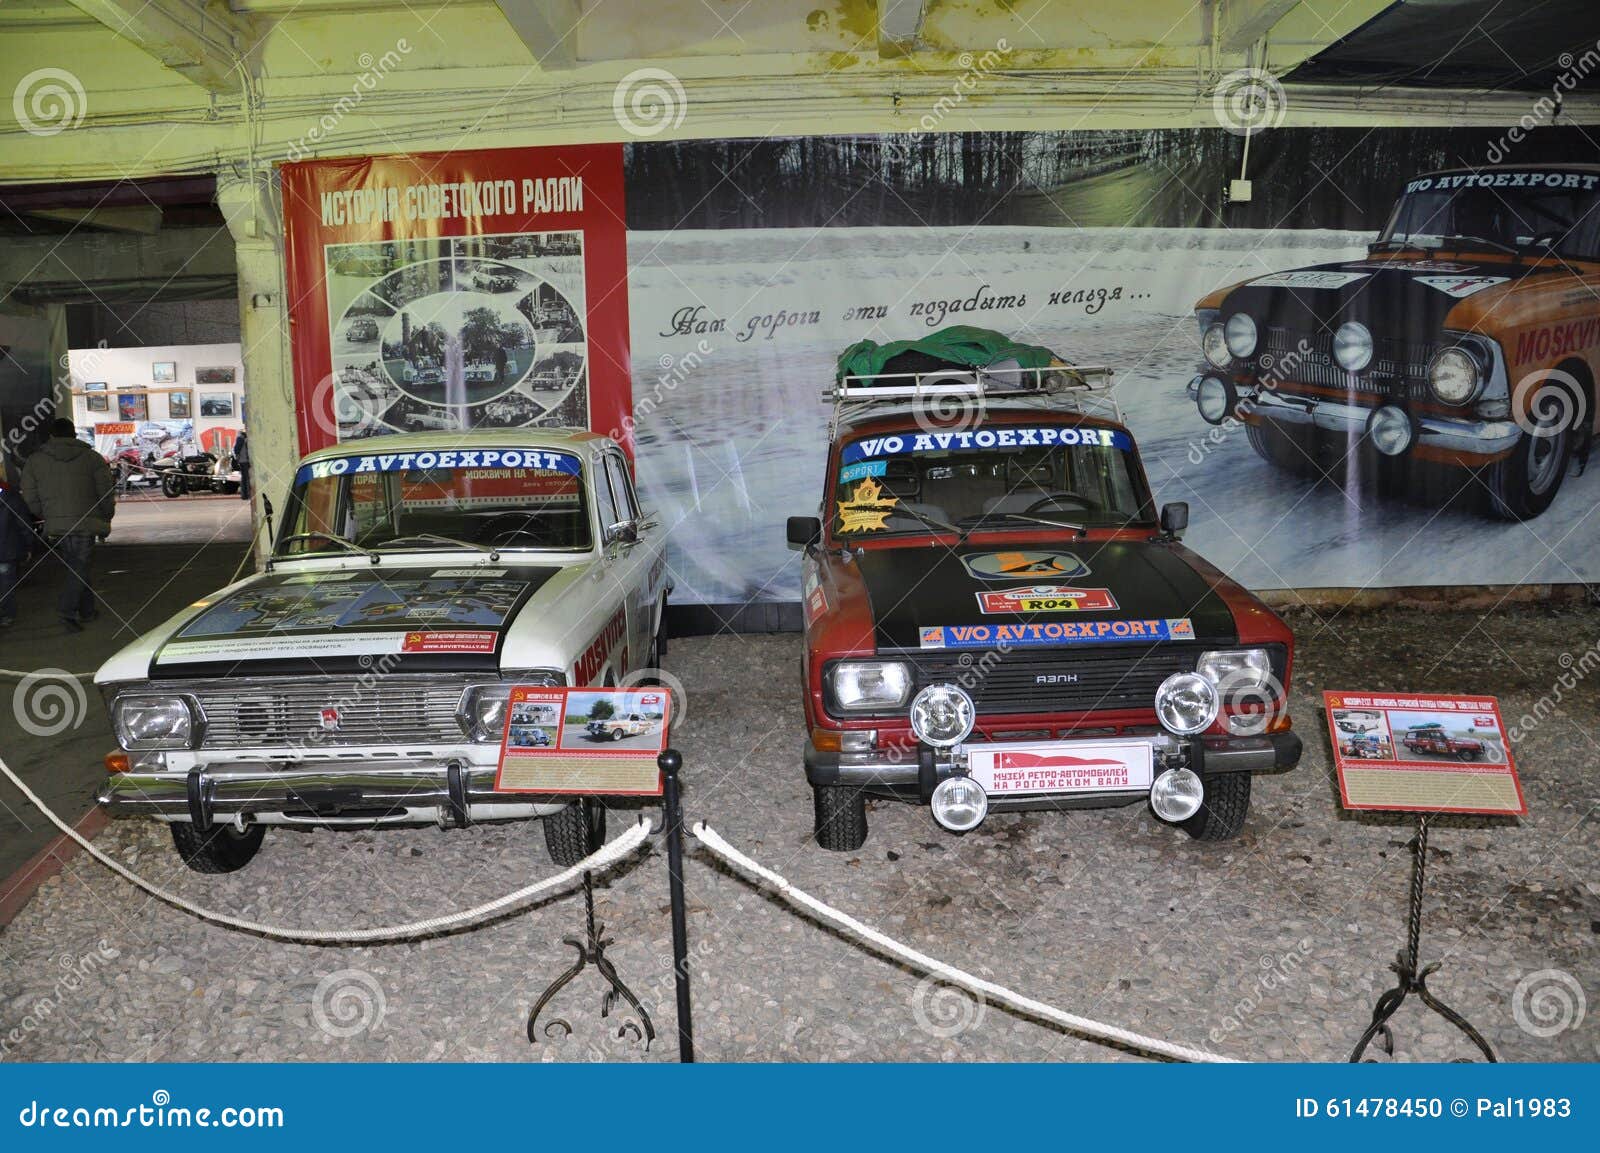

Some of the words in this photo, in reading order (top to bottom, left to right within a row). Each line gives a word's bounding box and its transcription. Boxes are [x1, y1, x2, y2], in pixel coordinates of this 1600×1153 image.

[1407, 179, 1432, 193] V/O
[1434, 173, 1599, 190] AVTOEXPORT
[320, 188, 399, 226] ИСТОРИЯ
[405, 179, 516, 219] СОВЕТСКОГО
[522, 176, 584, 214] РАЛЛИ
[659, 305, 726, 338] Нам
[842, 304, 889, 321] эти
[860, 437, 905, 457] V/O
[913, 428, 1115, 451] AVTOEXPORT
[356, 450, 562, 472] AVTOEXPORT
[465, 468, 511, 480] МОСКВИЧИ
[513, 468, 527, 479] НА
[951, 626, 989, 642] V/O
[996, 619, 1161, 641] AVTOEXPORT
[994, 769, 1025, 781] МУЗЕЙ
[1028, 766, 1128, 779] РЕТРО-АВТОМОБИЛЕЙ
[994, 782, 1008, 790] НА
[1015, 778, 1090, 789] РОГОЖСКОМ
[1098, 776, 1128, 786] ВАЛУ
